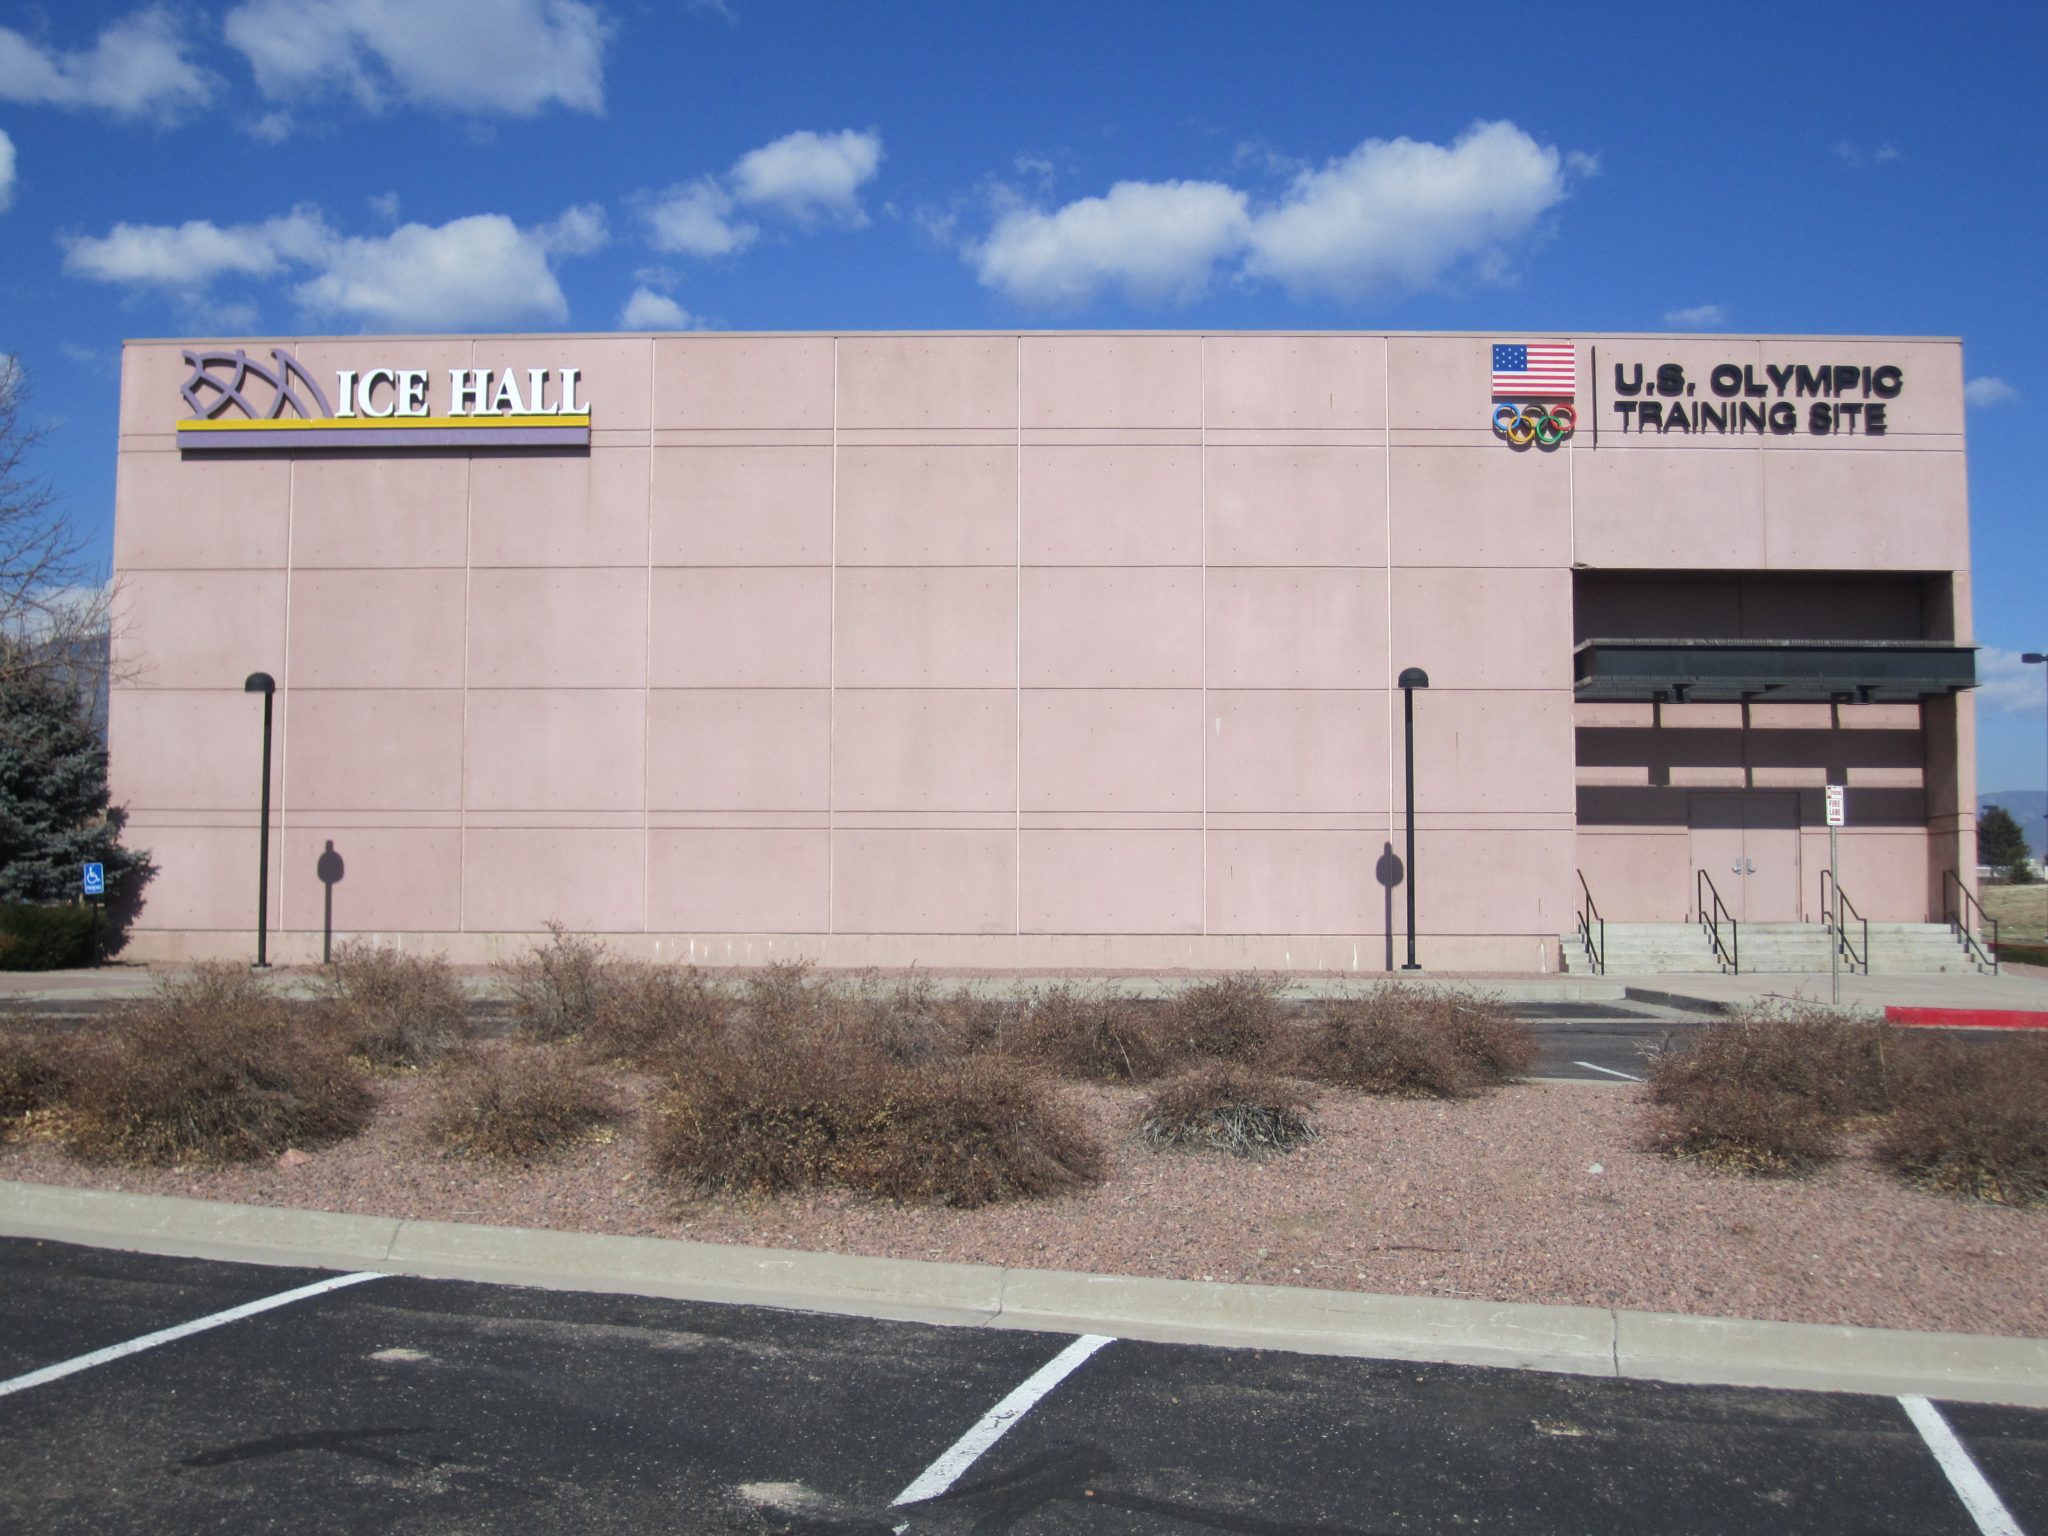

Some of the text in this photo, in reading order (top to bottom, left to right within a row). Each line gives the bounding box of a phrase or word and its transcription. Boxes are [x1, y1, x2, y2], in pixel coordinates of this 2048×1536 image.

[335, 367, 590, 418] ICE HALL
[1615, 363, 1903, 399] U.S. OLYMPIC
[1614, 400, 1887, 436] TRAINING SITE
